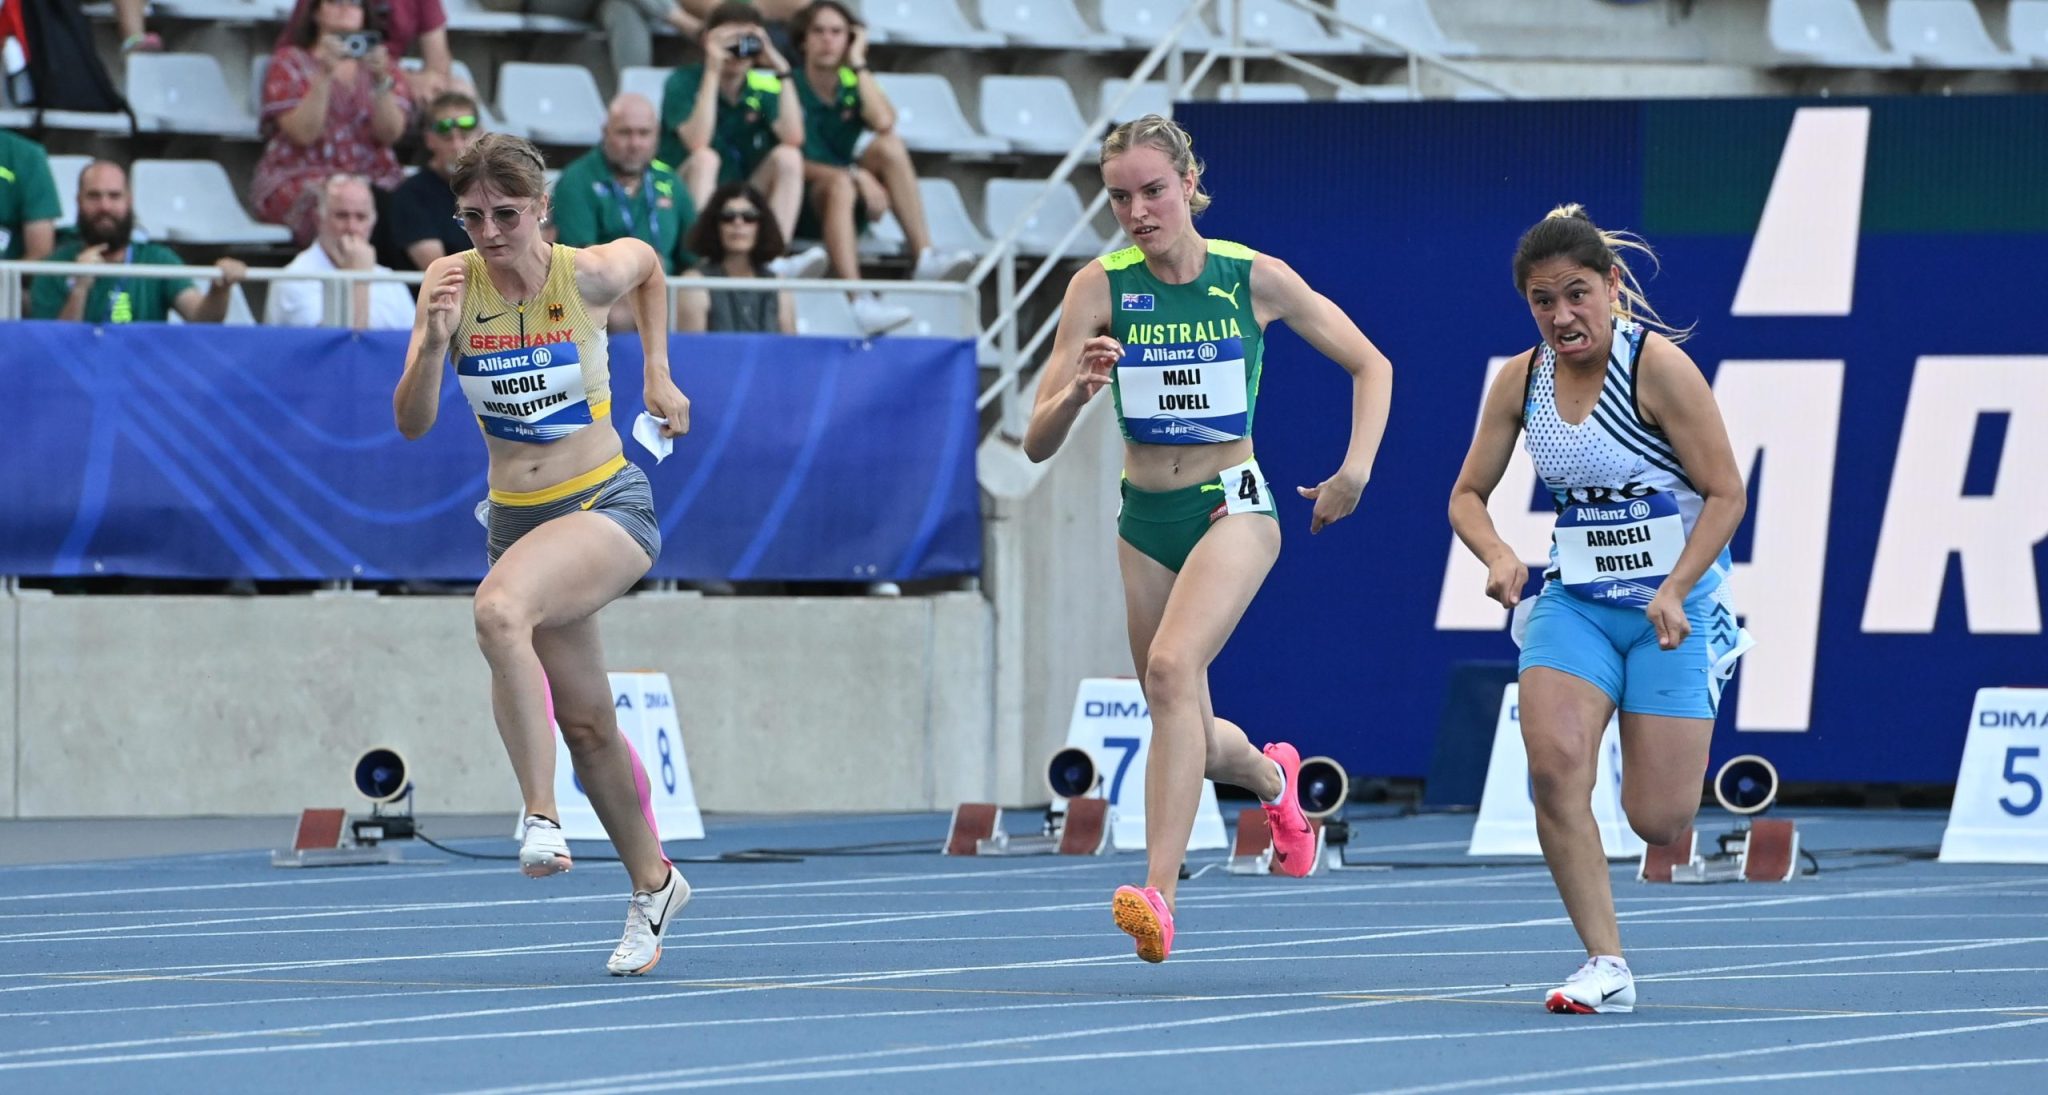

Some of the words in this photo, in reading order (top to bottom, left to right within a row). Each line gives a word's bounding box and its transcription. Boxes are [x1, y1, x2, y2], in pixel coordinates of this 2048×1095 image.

[470, 329, 573, 349] GERMANY
[1127, 318, 1241, 345] AUSTRALIA
[478, 355, 529, 372] Allianz
[1142, 348, 1195, 362] Allianz
[491, 374, 547, 396] NICOLE
[1163, 369, 1201, 386] MALI
[484, 391, 568, 417] NICOLEITZIK
[1158, 394, 1210, 411] LOVELL
[1238, 470, 1260, 505] 4
[1576, 507, 1628, 522] Allianz
[1586, 525, 1652, 548] ARACELI
[1595, 551, 1653, 573] ROTELA
[657, 727, 675, 795] 8
[1103, 737, 1141, 806] 7
[1998, 747, 2042, 817] 5
